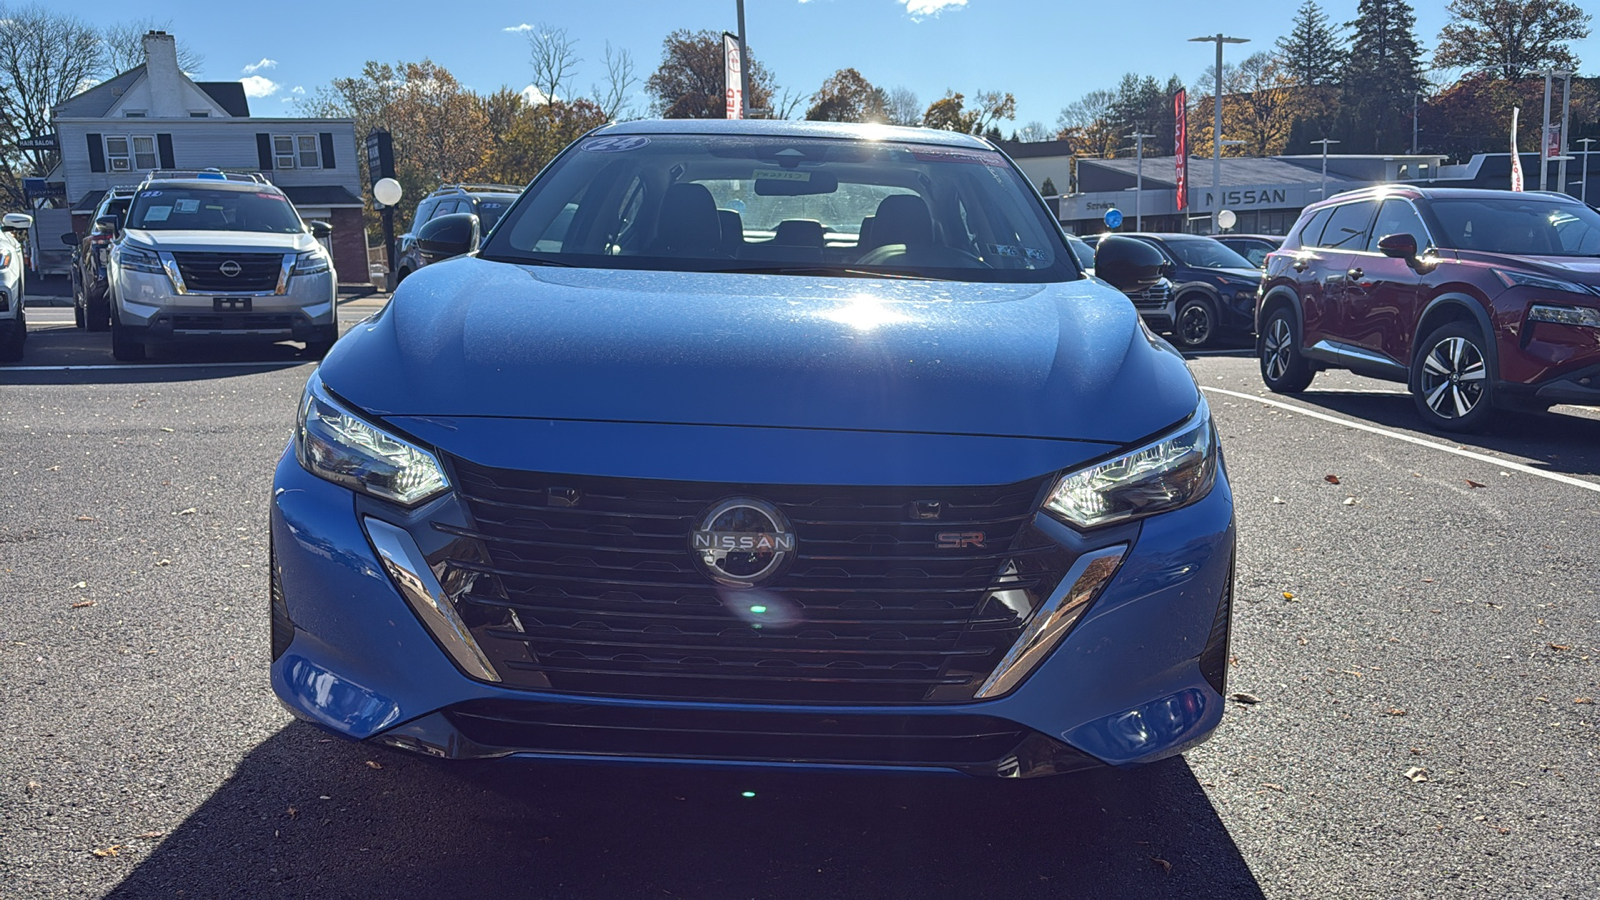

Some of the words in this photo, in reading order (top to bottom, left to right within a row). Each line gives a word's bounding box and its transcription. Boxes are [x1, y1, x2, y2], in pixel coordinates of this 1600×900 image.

[587, 137, 643, 151] 24
[1086, 201, 1116, 210] Service
[1206, 190, 1285, 206] NISSAN
[695, 534, 790, 549] NISSAN
[938, 533, 984, 548] SR
